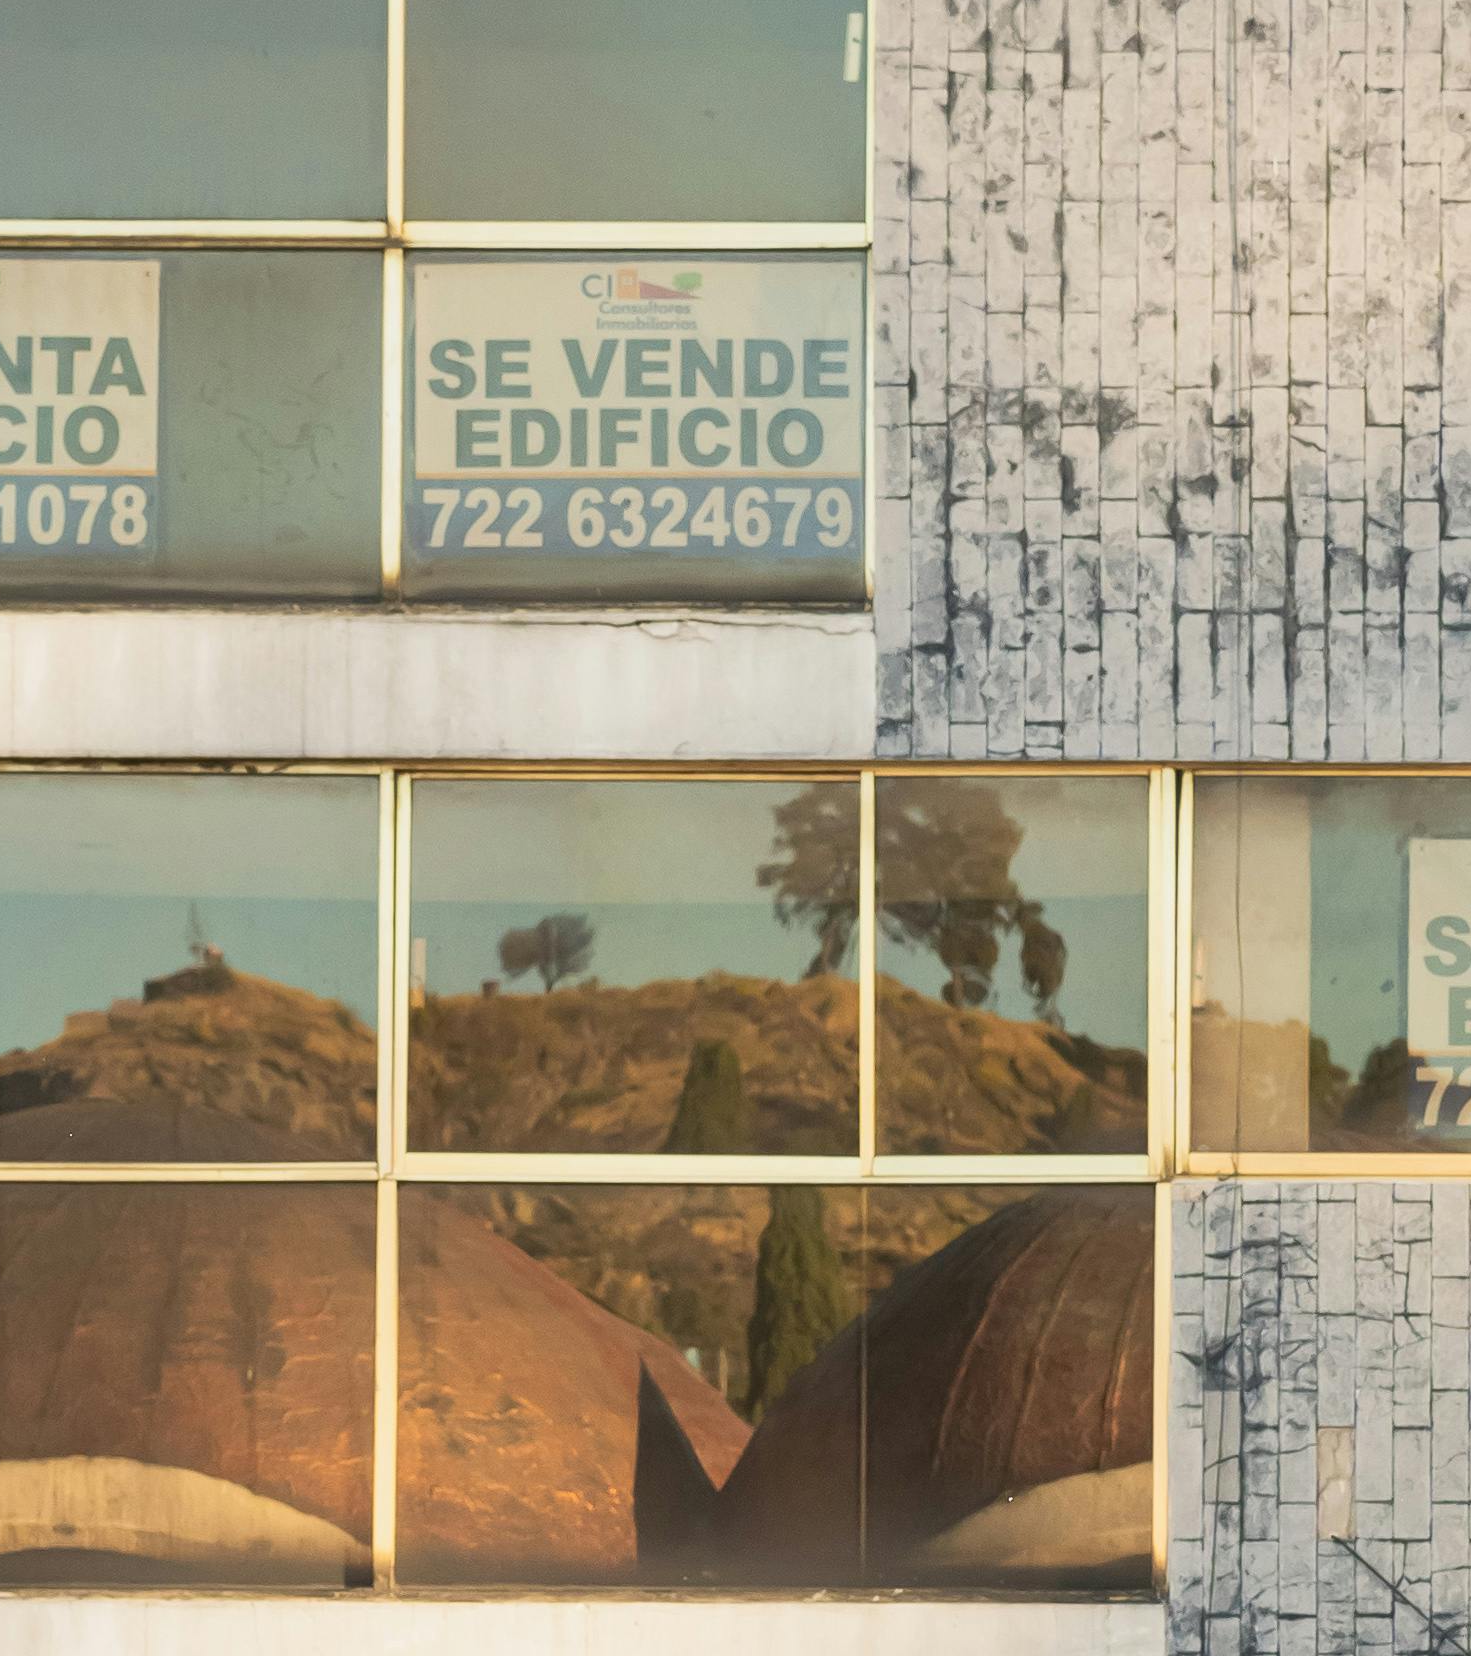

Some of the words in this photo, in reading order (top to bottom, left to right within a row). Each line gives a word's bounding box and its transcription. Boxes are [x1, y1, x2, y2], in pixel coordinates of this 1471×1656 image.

[427, 338, 532, 399] SE
[560, 338, 850, 399] VENDE
[454, 407, 825, 469] EDIFICIO
[422, 486, 544, 549] 722
[566, 485, 854, 549] 6324679
